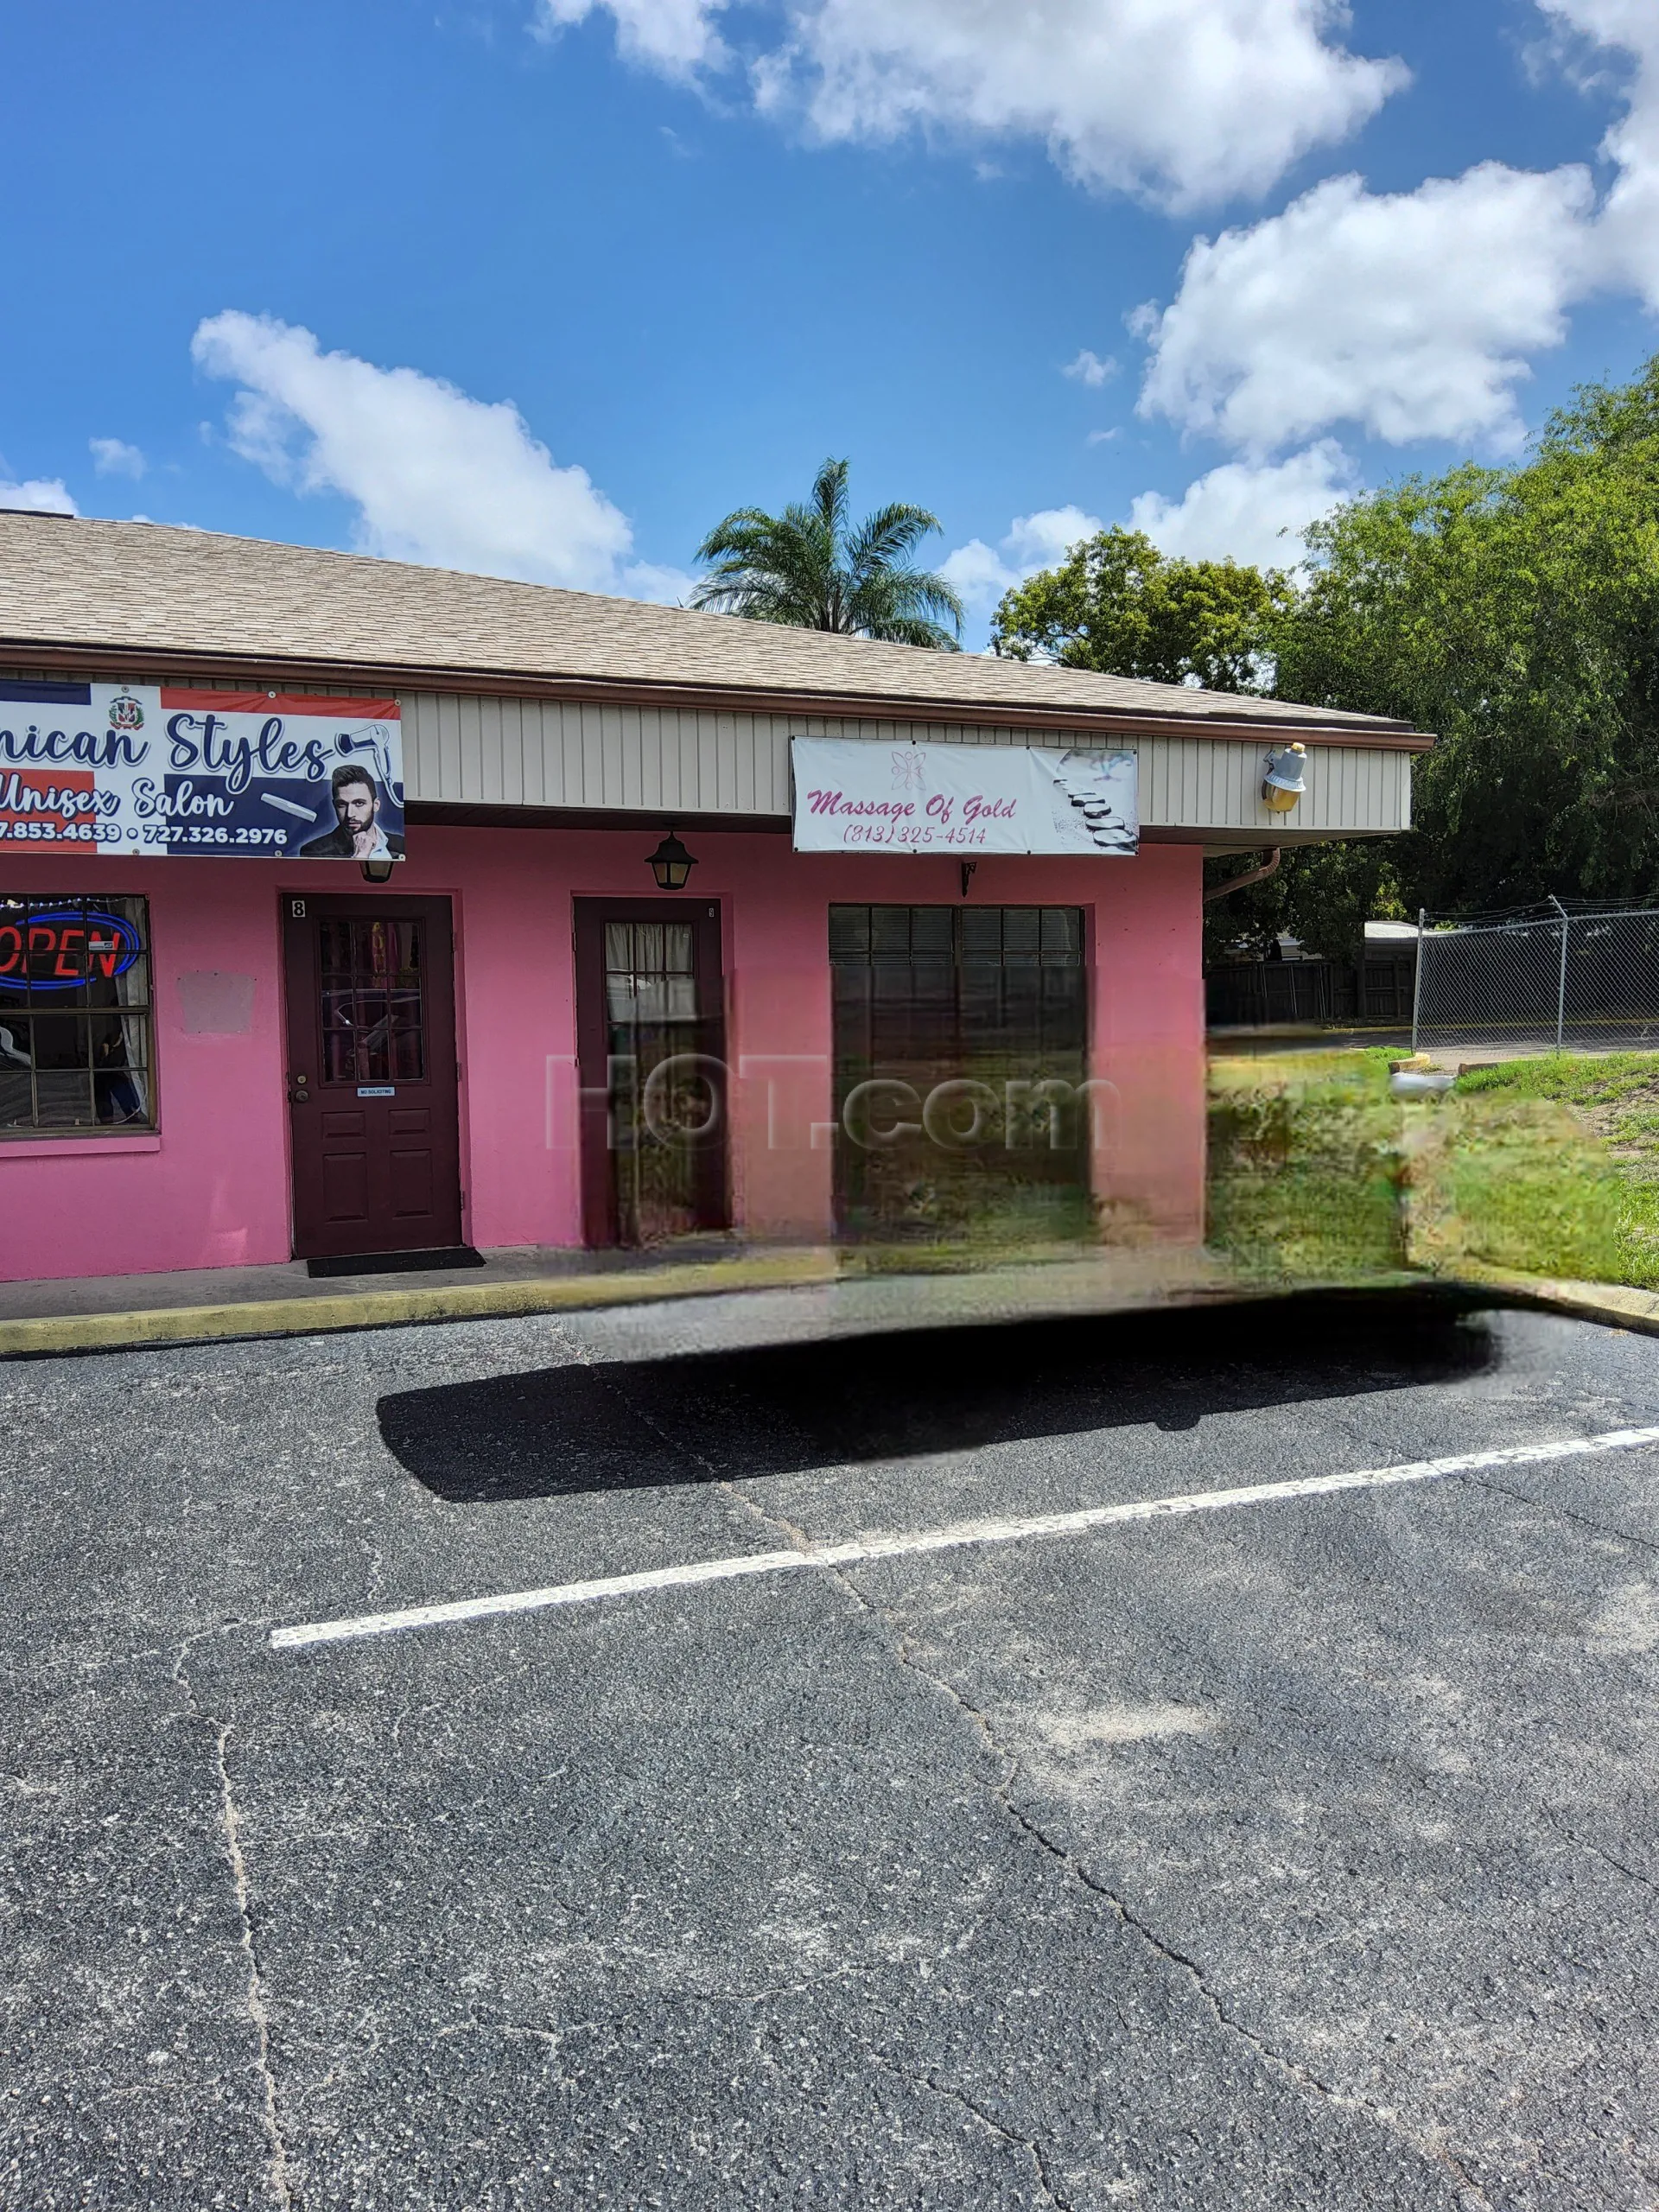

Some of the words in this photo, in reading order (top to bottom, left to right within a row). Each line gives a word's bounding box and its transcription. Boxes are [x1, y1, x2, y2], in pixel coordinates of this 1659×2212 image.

[167, 714, 334, 792] Styles
[0, 772, 120, 819] Unisex
[131, 778, 234, 818] Salon
[807, 790, 916, 823] Massage
[926, 793, 953, 824] Of
[963, 794, 1017, 825] Gold
[143, 824, 288, 845] 727.326.2976
[294, 902, 304, 916] 8
[0, 925, 121, 978] OPEN
